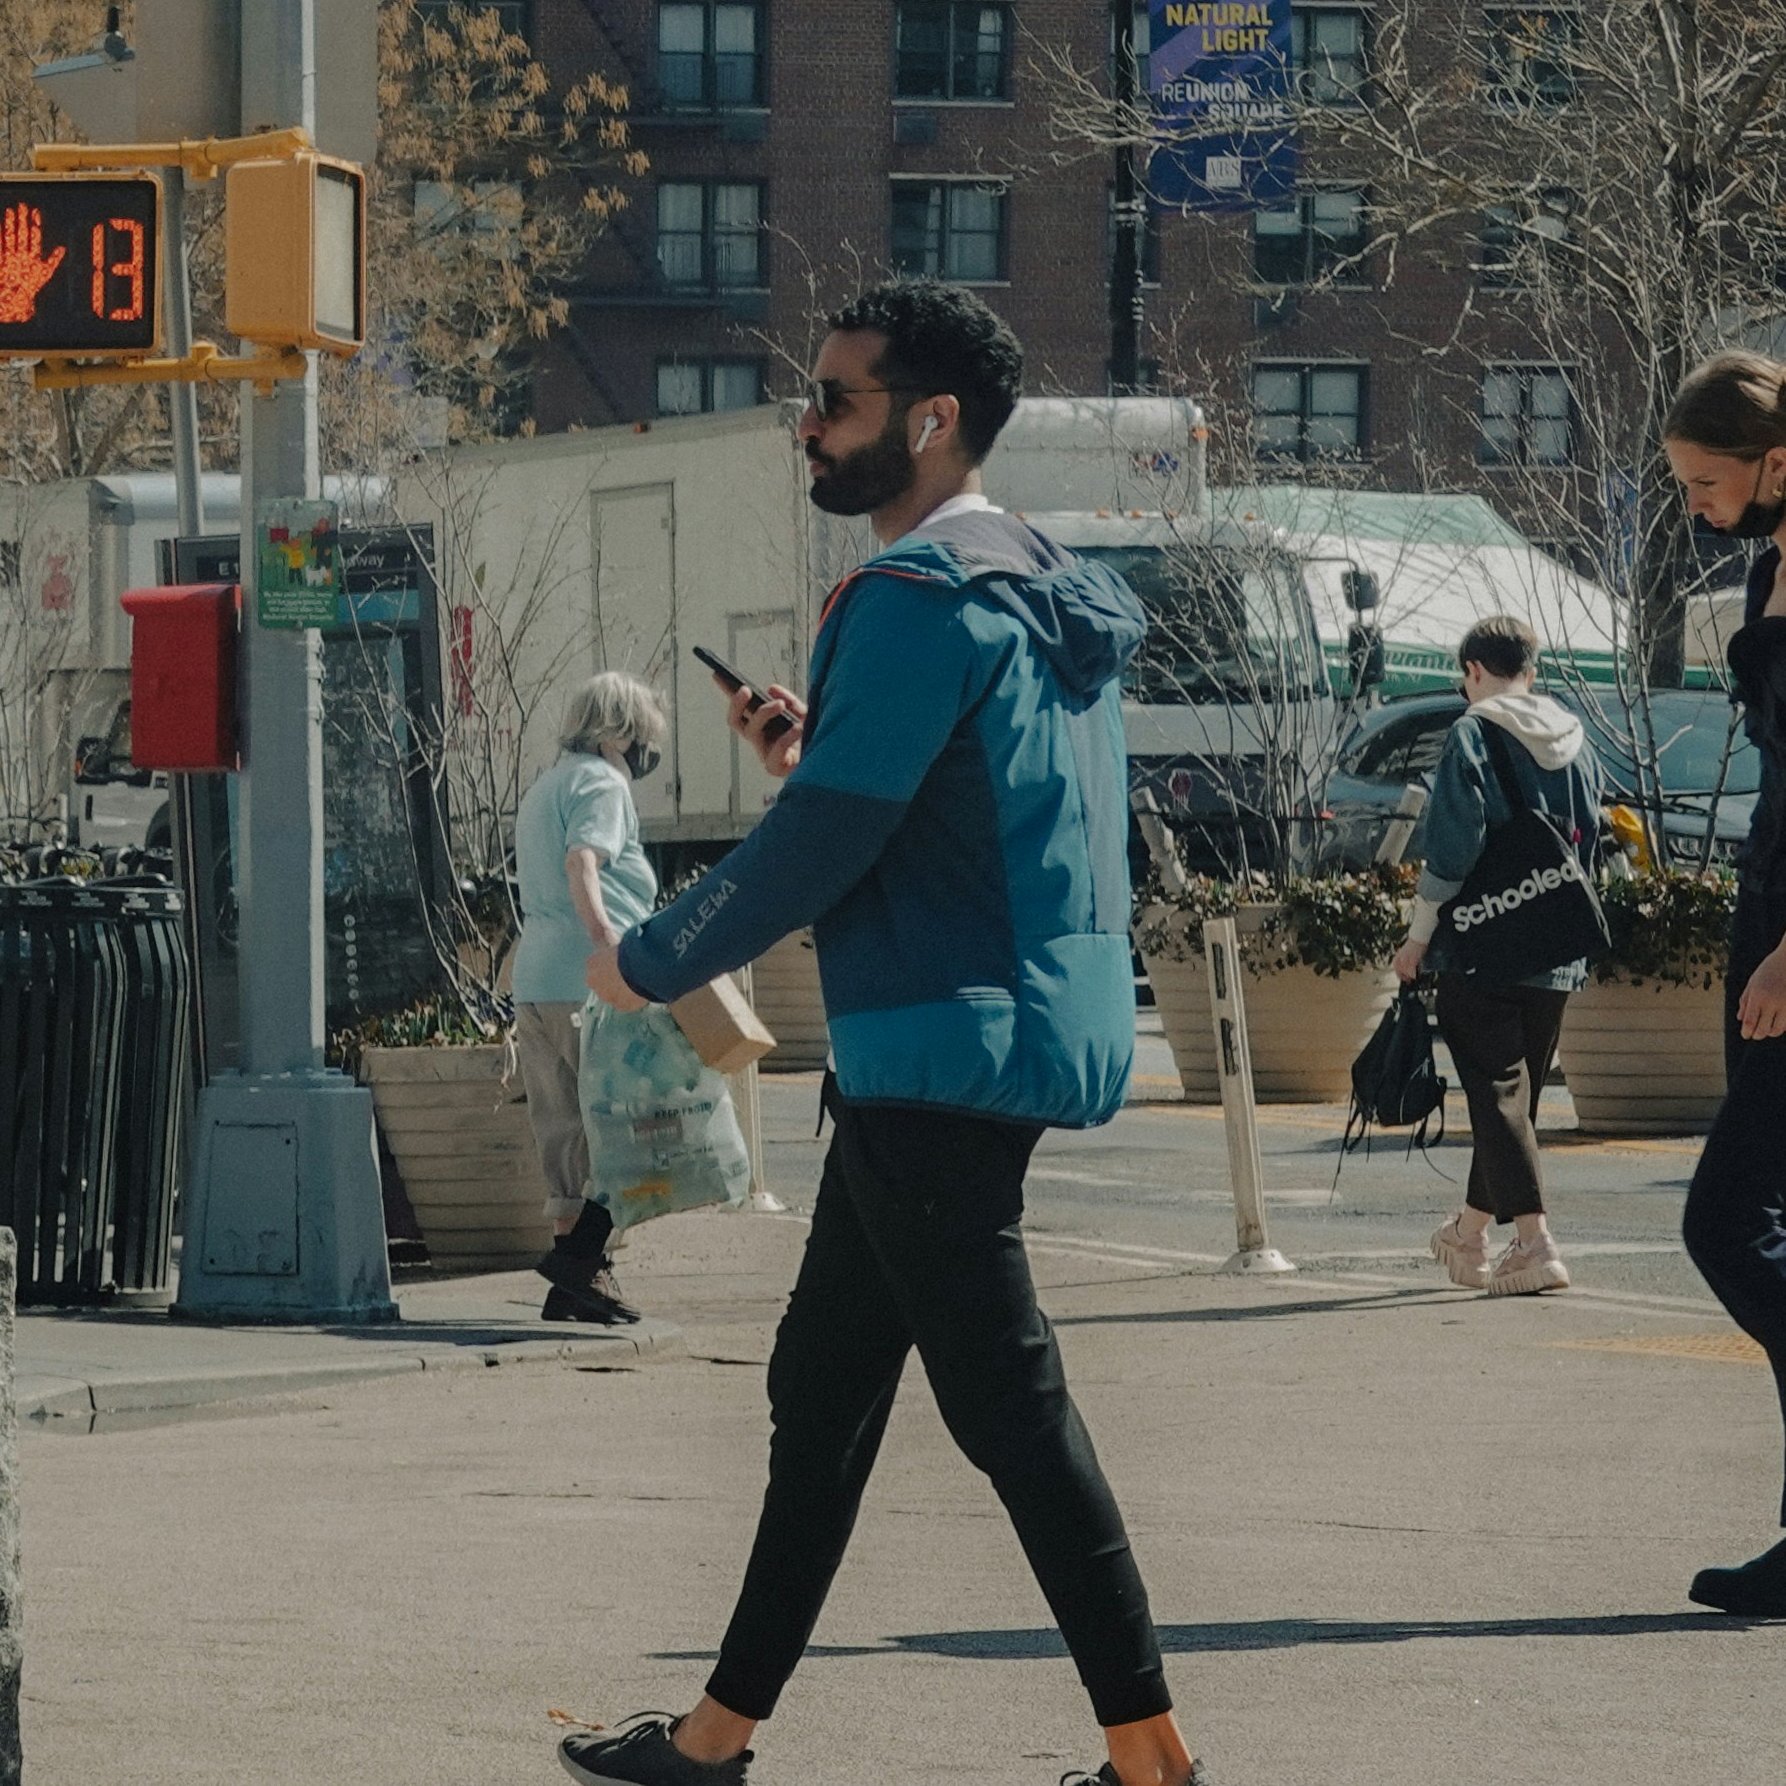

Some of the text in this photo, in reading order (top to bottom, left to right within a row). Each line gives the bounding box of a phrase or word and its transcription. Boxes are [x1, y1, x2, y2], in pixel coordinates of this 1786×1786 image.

[1166, 4, 1273, 26] NATURAL
[1202, 29, 1269, 53] LIGHT
[1161, 82, 1252, 103] REUNION
[92, 218, 144, 321] 13
[1453, 860, 1585, 932] Schooled
